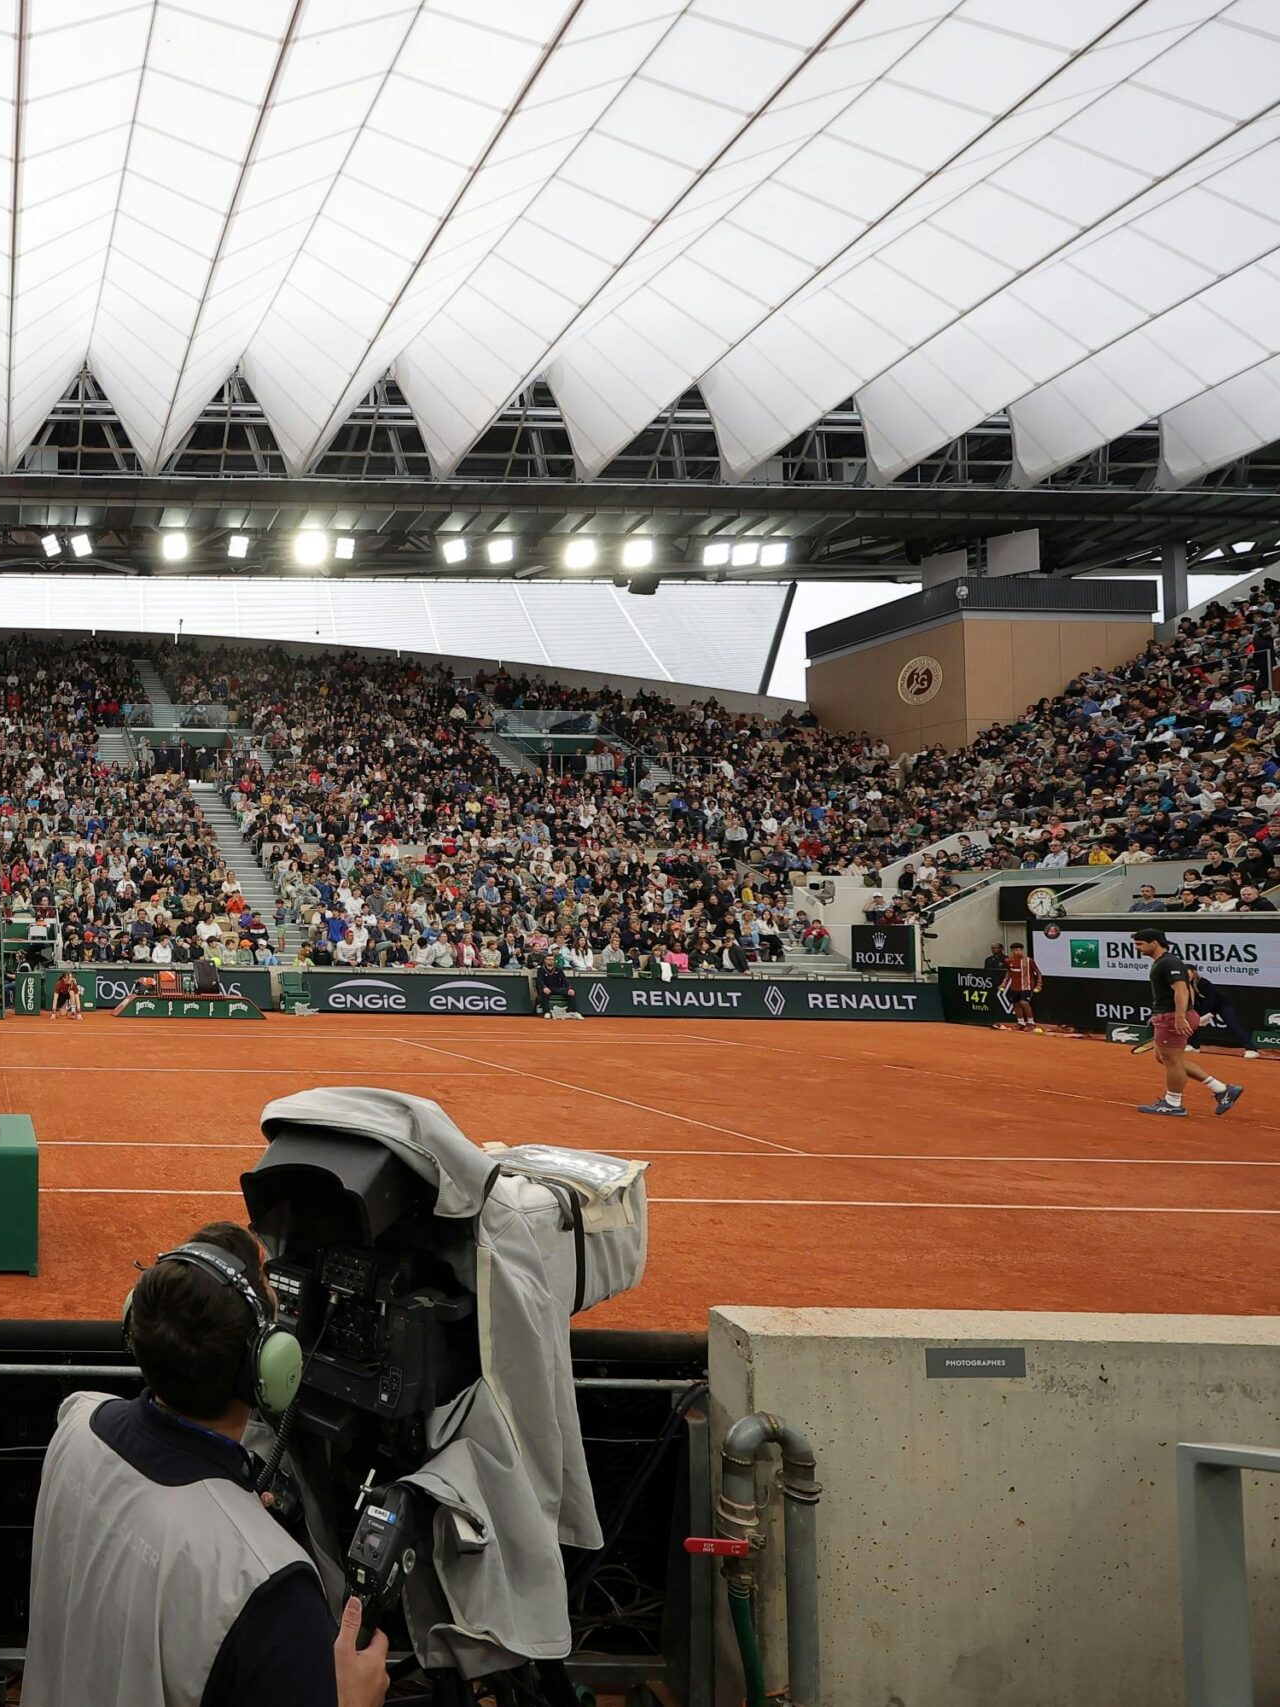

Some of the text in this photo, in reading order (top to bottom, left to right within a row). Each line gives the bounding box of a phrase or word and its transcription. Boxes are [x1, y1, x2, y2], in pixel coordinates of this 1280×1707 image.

[855, 952, 905, 965] ROLEX
[1169, 943, 1258, 963] ARIBAS
[1107, 961, 1149, 971] La banque
[1206, 966, 1221, 974] qui
[1224, 966, 1260, 977] change
[957, 973, 993, 989] Infosys
[632, 990, 917, 1010] RENAULT RENAULT
[963, 990, 988, 1003] 147
[972, 1004, 989, 1012] km/h
[1095, 1003, 1134, 1020] BNP
[1257, 1036, 1280, 1044] LACO
[945, 1359, 1006, 1367] PHOTOGRAPHES
[367, 1519, 385, 1531] Canon
